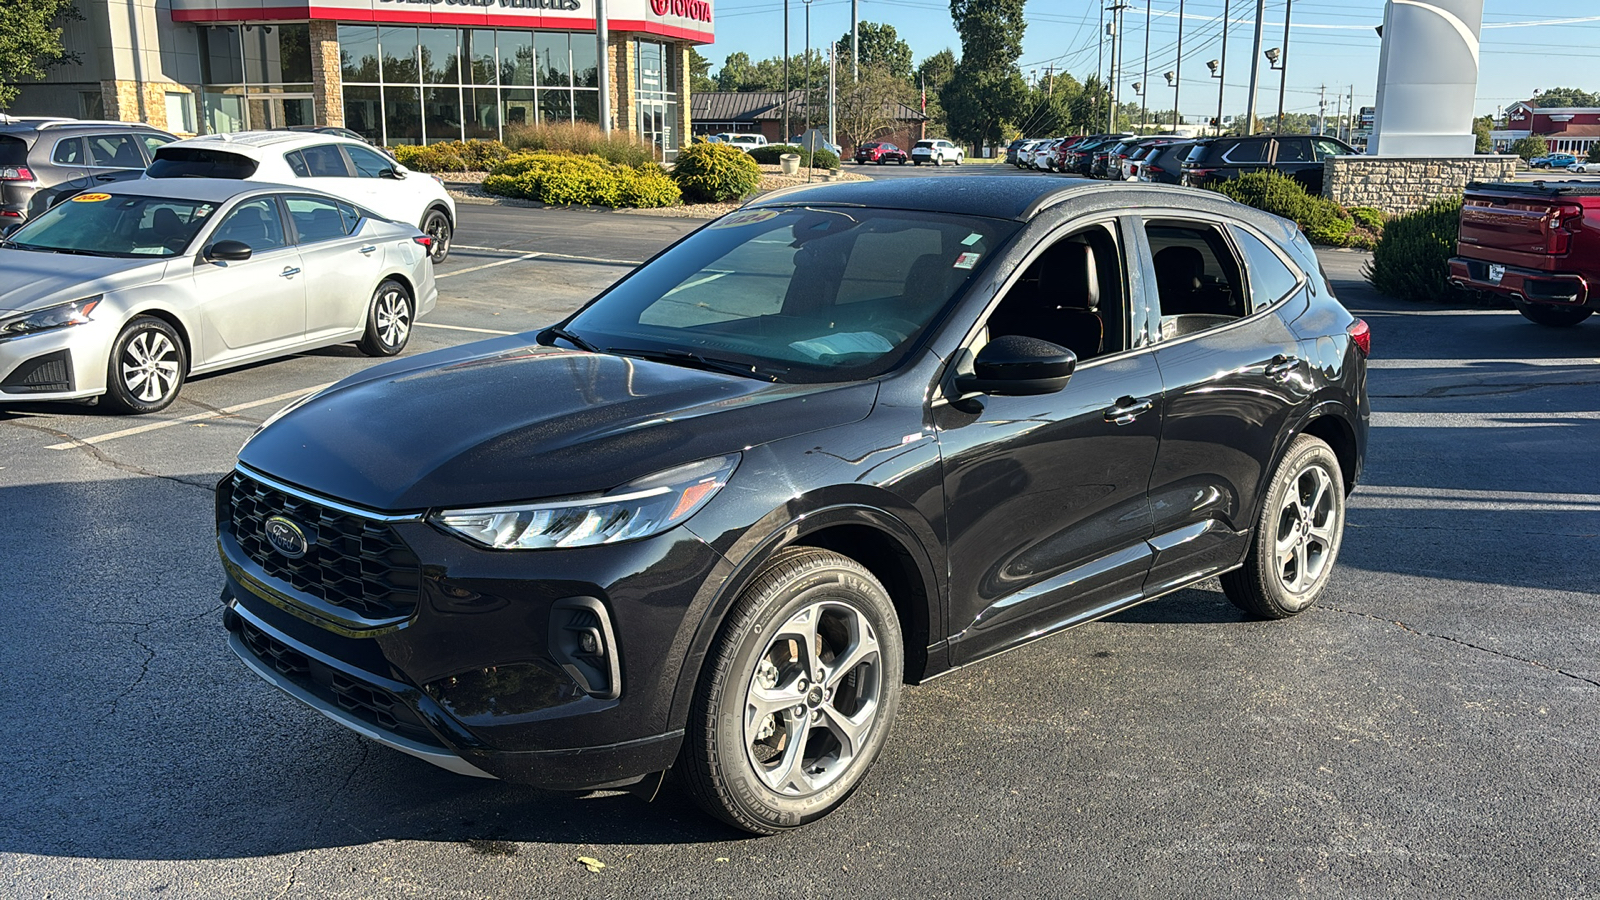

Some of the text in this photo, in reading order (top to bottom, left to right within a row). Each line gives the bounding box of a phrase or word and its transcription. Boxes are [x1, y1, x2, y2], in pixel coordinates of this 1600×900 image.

[671, 0, 712, 22] TOYOTA
[272, 525, 294, 551] Ford
[735, 779, 780, 820] MICHELIN
